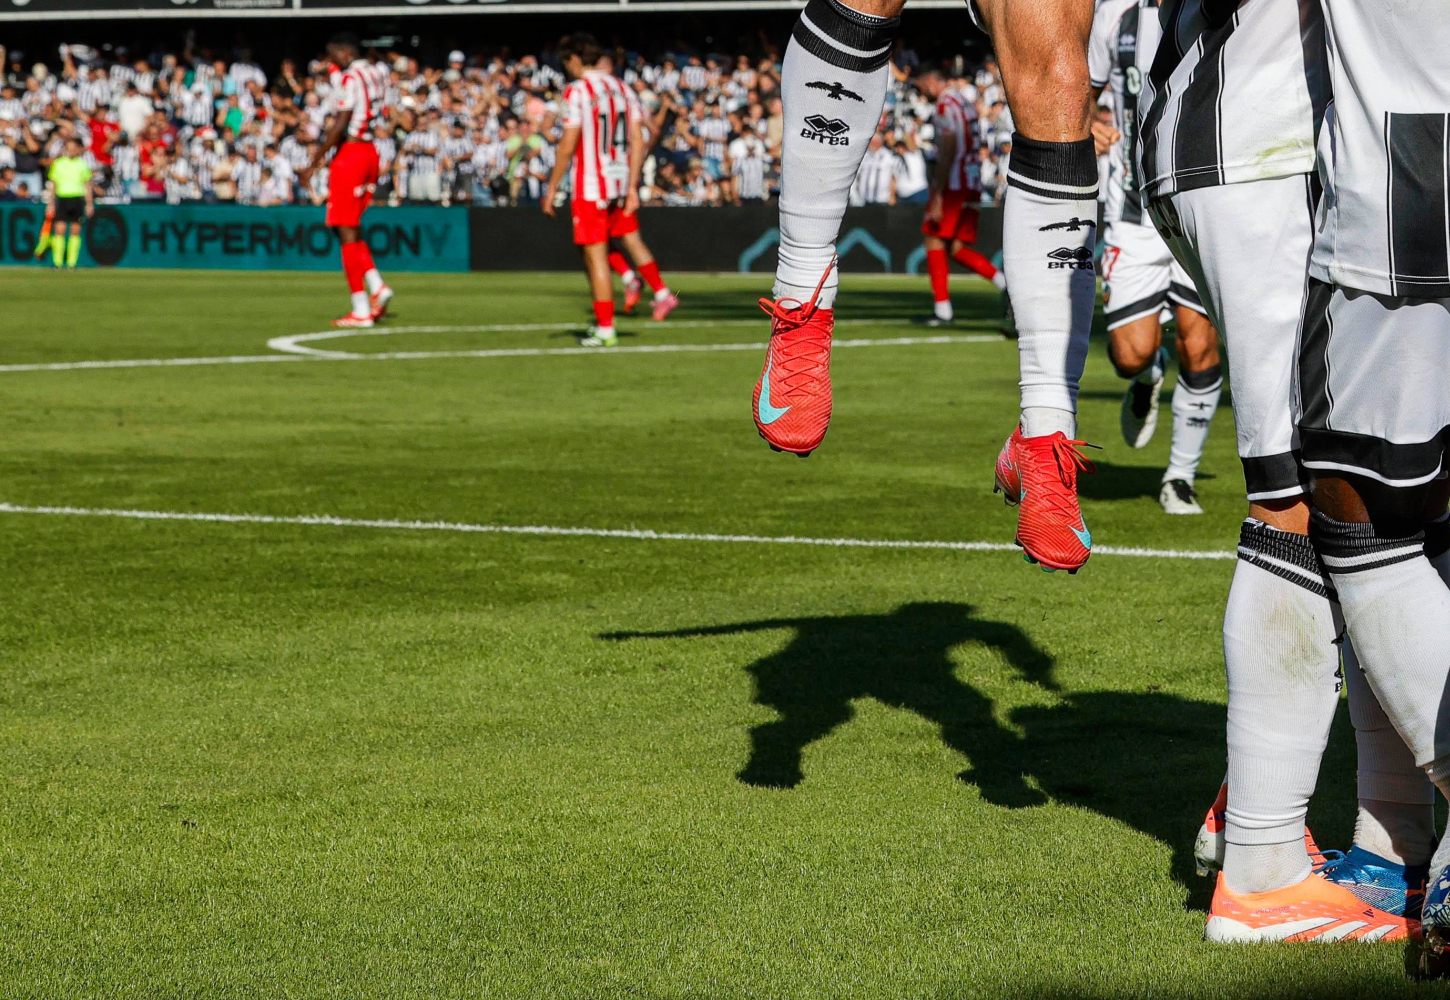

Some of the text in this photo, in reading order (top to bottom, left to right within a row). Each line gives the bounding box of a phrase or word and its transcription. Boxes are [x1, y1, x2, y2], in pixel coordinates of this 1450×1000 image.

[599, 111, 627, 155] 14
[800, 128, 849, 146] errea
[141, 221, 421, 256] HYPERMOON
